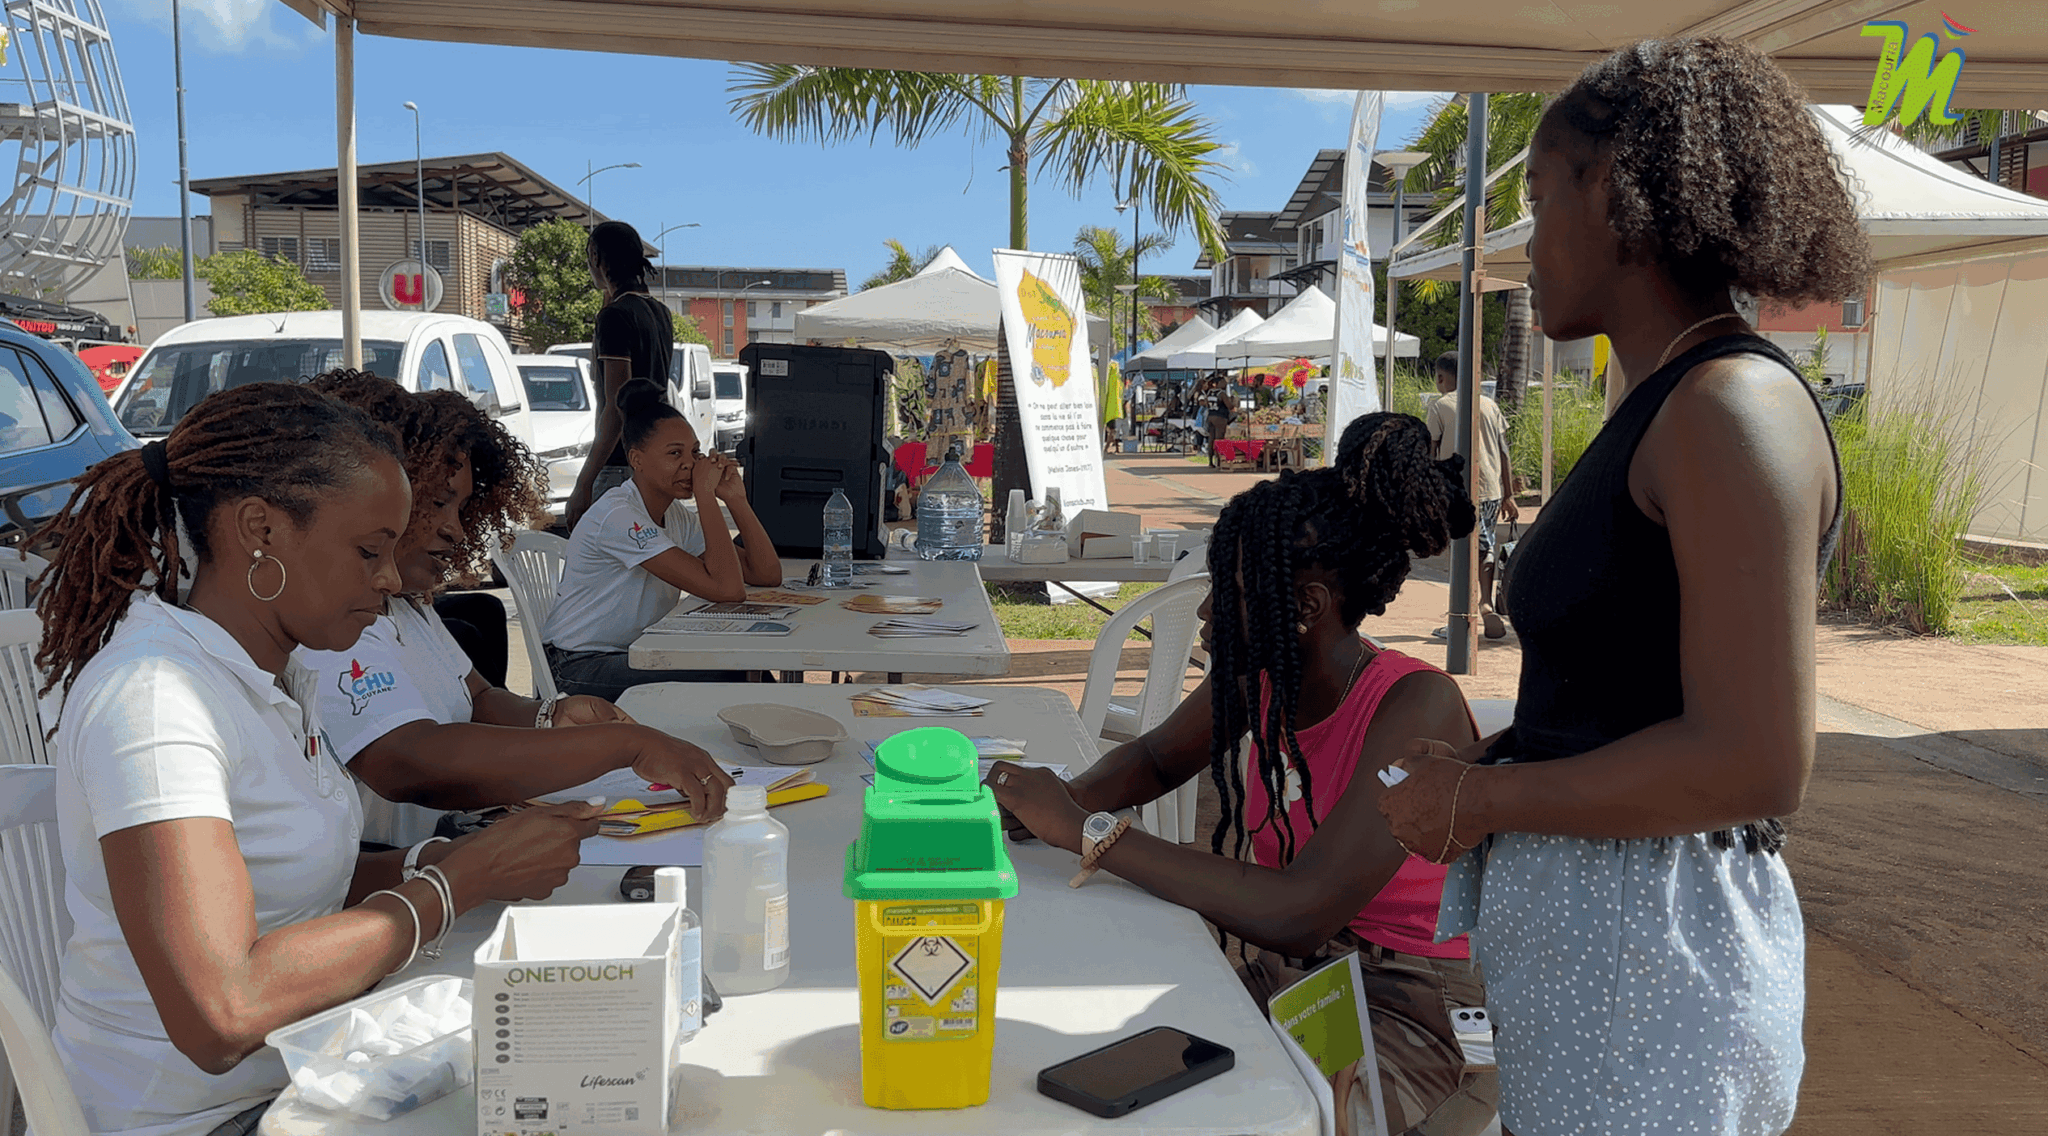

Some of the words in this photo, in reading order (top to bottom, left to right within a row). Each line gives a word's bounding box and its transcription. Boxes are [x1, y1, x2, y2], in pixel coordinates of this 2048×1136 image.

[394, 273, 423, 304] U
[1026, 323, 1067, 348] Macouria
[1059, 402, 1072, 410] aller
[1042, 434, 1060, 443] quelque
[1076, 434, 1087, 442] pour
[636, 526, 658, 540] CHU
[351, 671, 396, 696] CHU
[361, 686, 393, 700] GUYANE
[507, 965, 634, 985] ONETOUCH
[1298, 1003, 1317, 1021] votre
[1316, 988, 1341, 1010] famille
[580, 1075, 635, 1089] Lifescan
